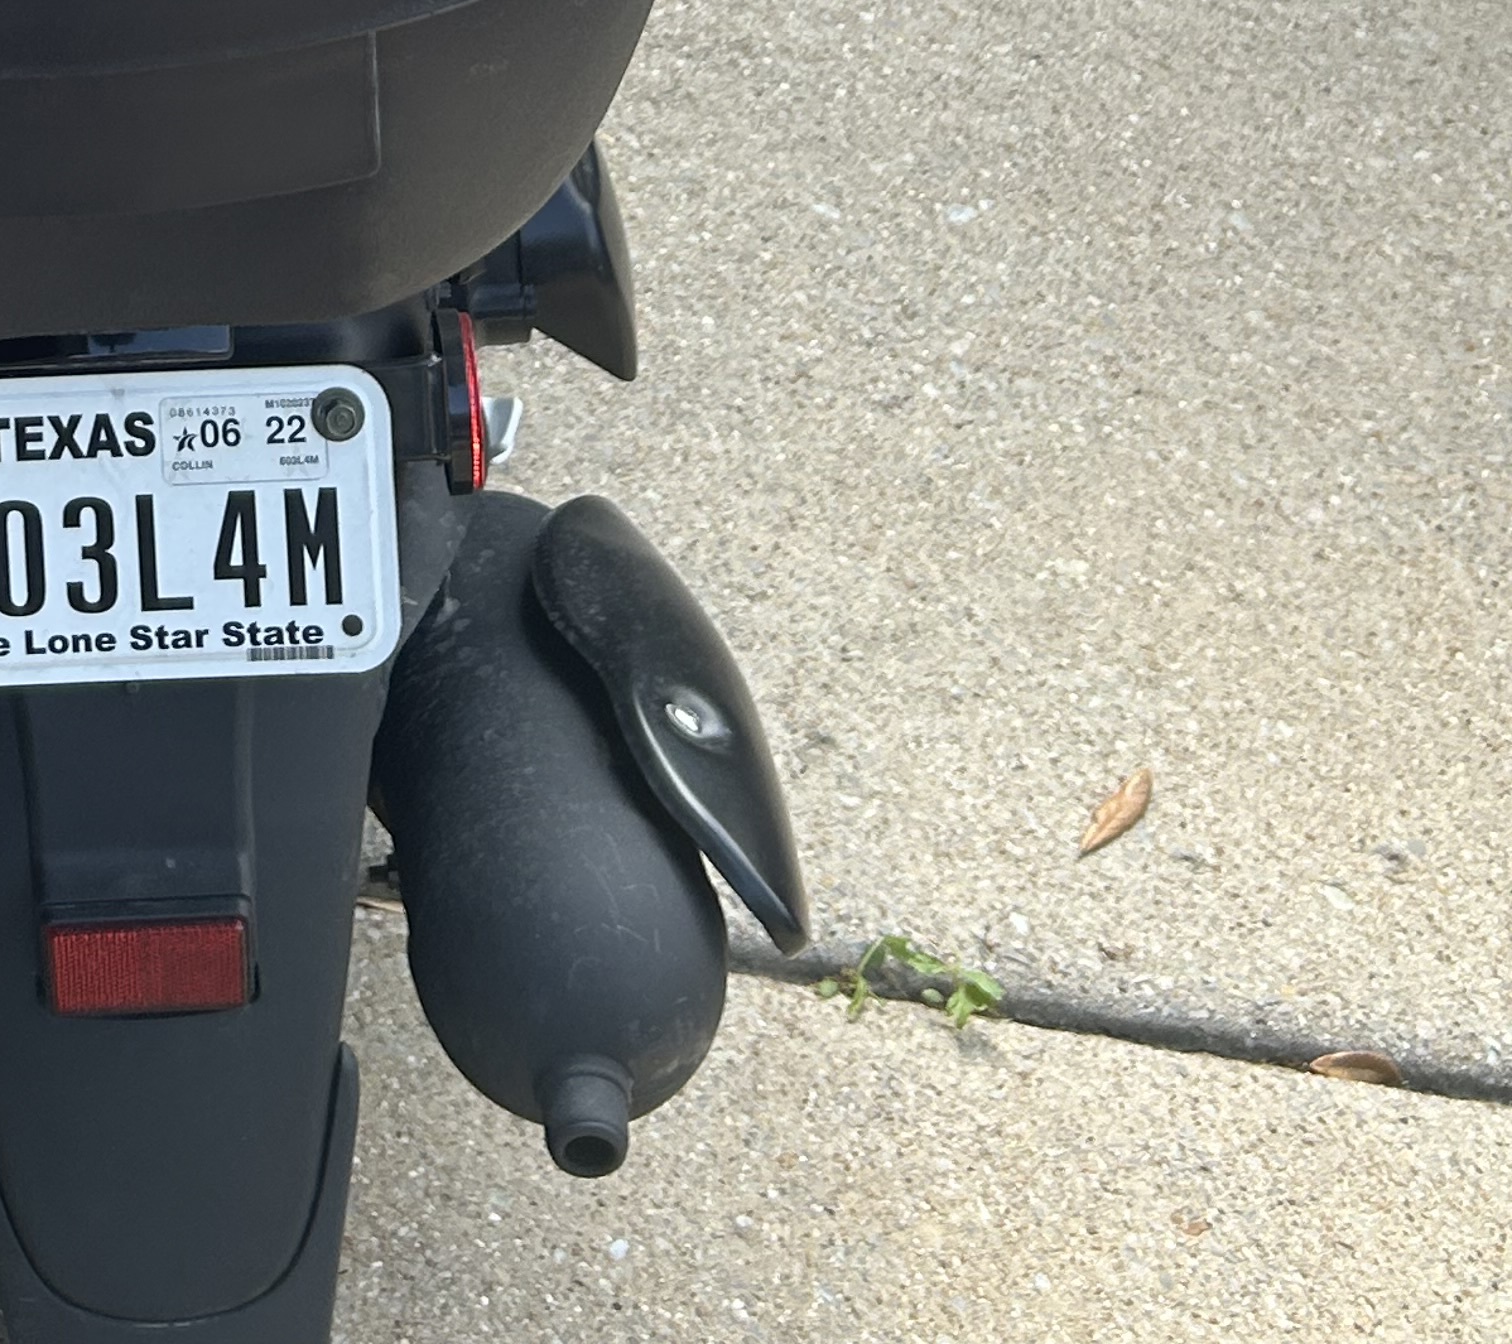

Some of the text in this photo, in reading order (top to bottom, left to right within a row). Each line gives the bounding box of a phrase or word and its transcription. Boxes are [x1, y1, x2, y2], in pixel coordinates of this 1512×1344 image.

[200, 414, 307, 448] 06 22
[24, 629, 117, 655] Lone
[130, 624, 209, 651] Star
[222, 619, 324, 647] State
